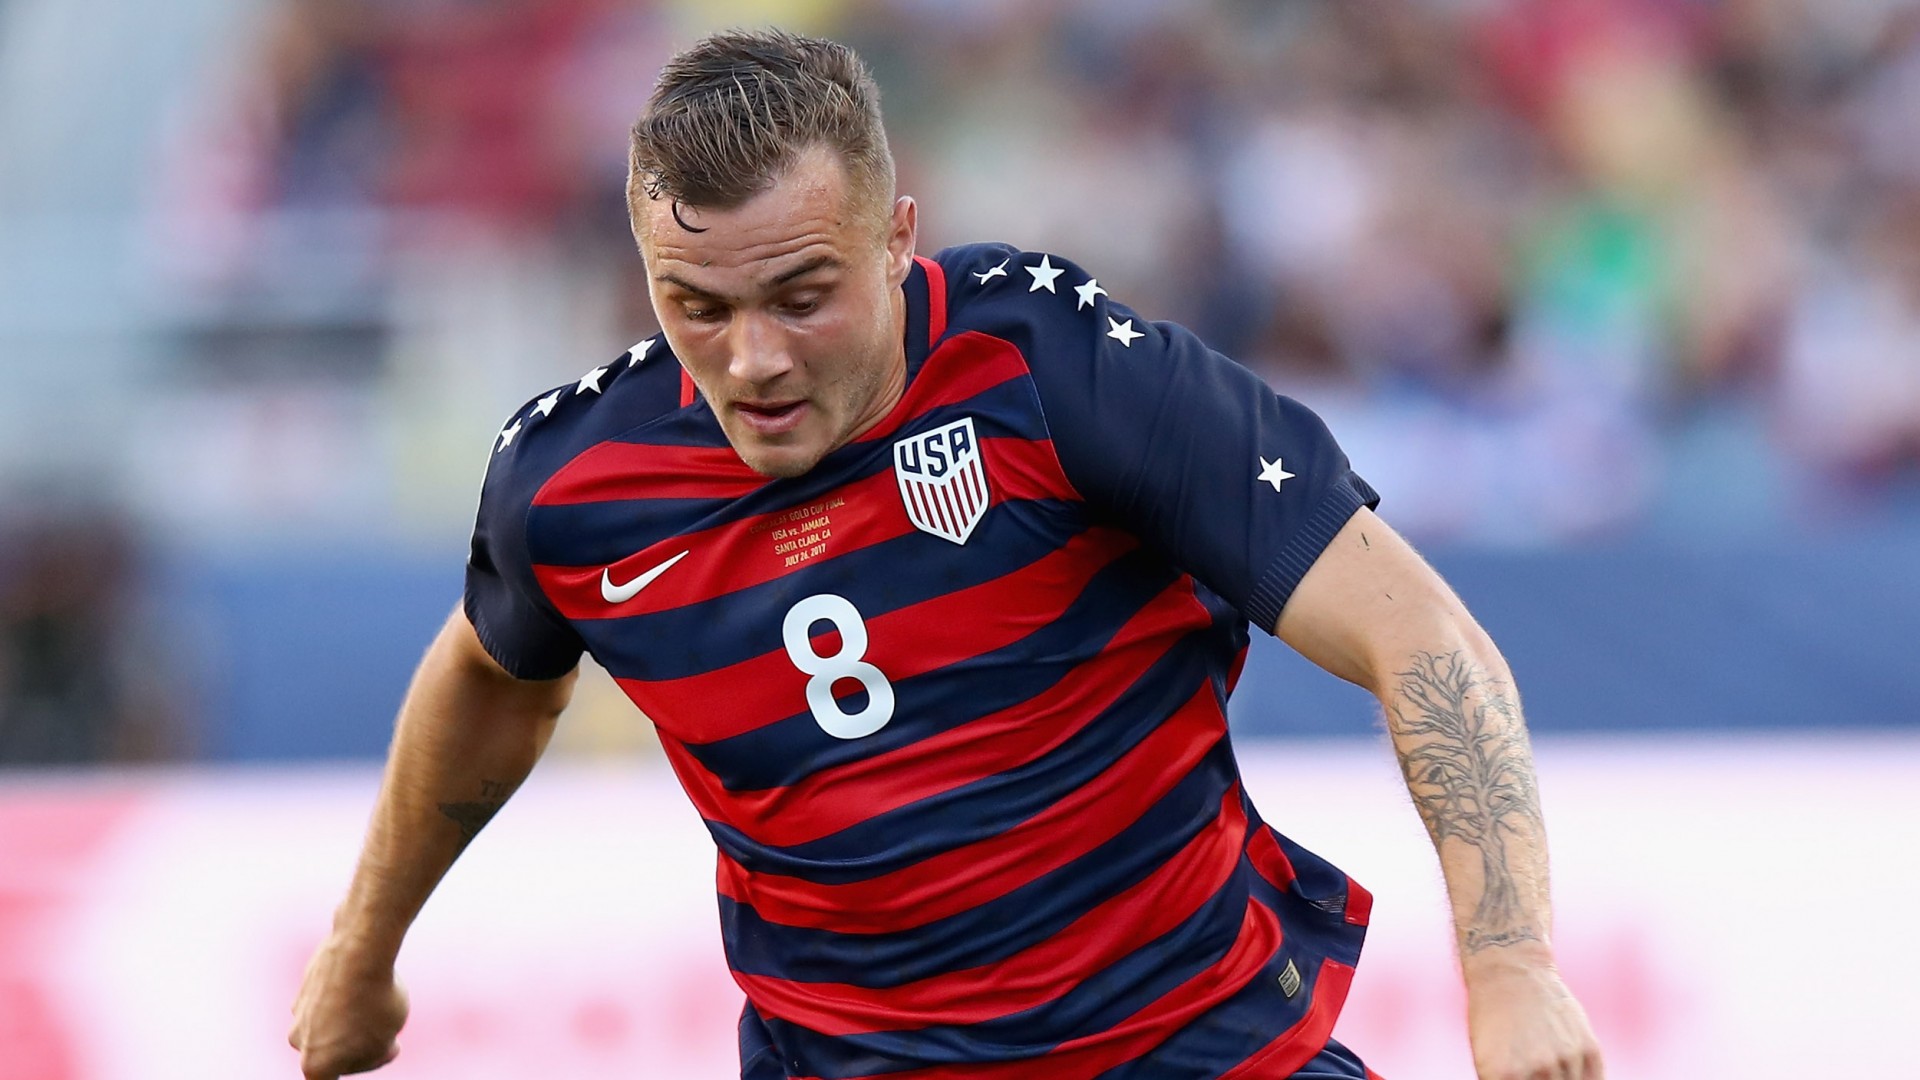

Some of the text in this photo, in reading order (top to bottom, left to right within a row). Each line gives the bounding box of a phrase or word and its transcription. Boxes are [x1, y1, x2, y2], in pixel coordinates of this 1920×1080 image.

[900, 425, 971, 477] USA
[789, 508, 809, 521] GOLD
[810, 505, 824, 515] CUP
[826, 497, 845, 511] FINAL
[772, 515, 831, 540] USA vs. JAMAICA
[774, 541, 798, 555] SANTA
[822, 529, 831, 541] CA
[784, 553, 800, 567] JULY
[811, 543, 826, 556] 2017
[782, 594, 895, 739] 8
